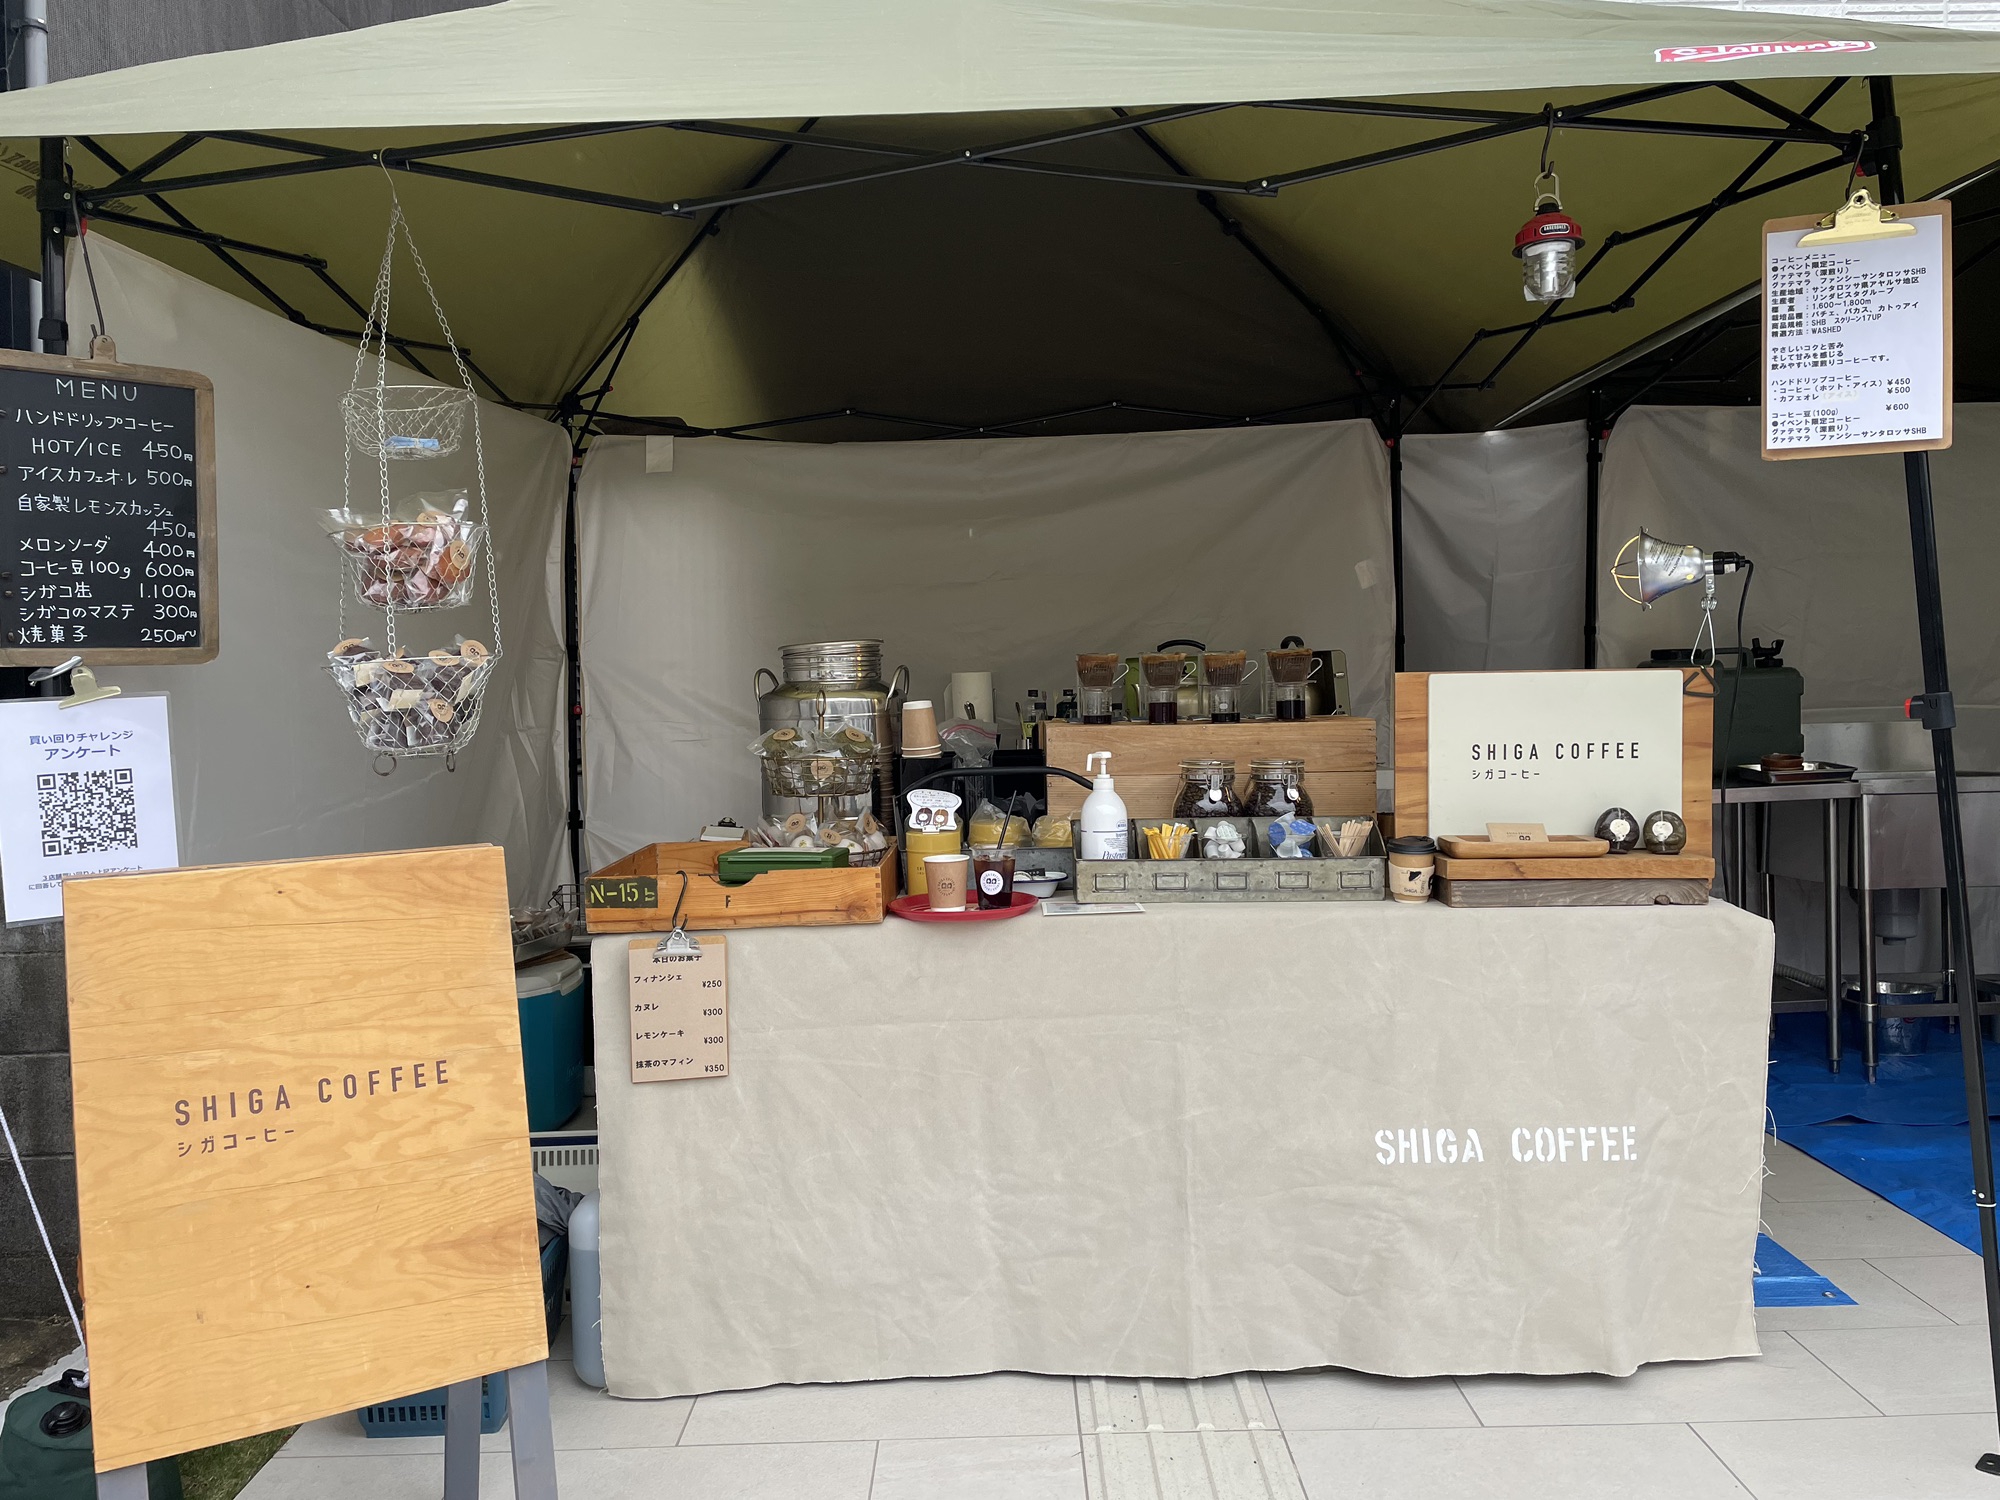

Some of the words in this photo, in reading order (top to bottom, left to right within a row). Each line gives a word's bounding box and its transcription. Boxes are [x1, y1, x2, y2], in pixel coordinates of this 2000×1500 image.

[1771, 252, 1836, 264] コーヒーメニュー
[1771, 278, 1812, 289] グァテマラ
[1771, 342, 1844, 354] やさしいコクと苦み
[1771, 350, 1844, 362] そして甘みを感じる
[1771, 374, 1861, 387] ハンドドリップコーヒー
[55, 378, 138, 402] MENU
[1887, 386, 1911, 394] ¥500
[1885, 403, 1909, 411] ¥600
[15, 408, 174, 433] ハンドドリップコーヒー
[1771, 434, 1811, 444] グァテマラ
[31, 437, 122, 458] HOT/ICE
[142, 440, 193, 462] 450円
[147, 469, 193, 488] 500円
[18, 493, 174, 518] 自家製レモンスカッシュ
[146, 519, 196, 539] 450円
[20, 534, 112, 555] メロンソーダ
[143, 540, 195, 559] 400円
[145, 563, 194, 579] 600円
[19, 604, 136, 622] シガコのマステ
[153, 604, 198, 621] 300円
[29, 730, 134, 746] 買い回りチャレンジ
[44, 744, 121, 761] アンケート
[1471, 742, 1539, 761] SHIGA
[1555, 742, 1640, 760] COFFEE
[1472, 768, 1541, 780] シガコーヒー
[634, 974, 683, 984] フィナンシェ
[702, 980, 722, 988] ¥250
[634, 1003, 660, 1012] カヌレ
[702, 1008, 723, 1016] ¥300
[636, 1030, 684, 1040] レモンケーキ
[704, 1036, 724, 1044] ¥300
[636, 1058, 694, 1069] 抹茶のマフィン
[704, 1064, 725, 1073] ¥350
[174, 1084, 291, 1127] SHIGA
[318, 1059, 449, 1104] COFFEE
[178, 1128, 295, 1158] シガコーヒー
[1374, 1126, 1485, 1166] SHIGA
[1510, 1126, 1638, 1164] COFFEE
